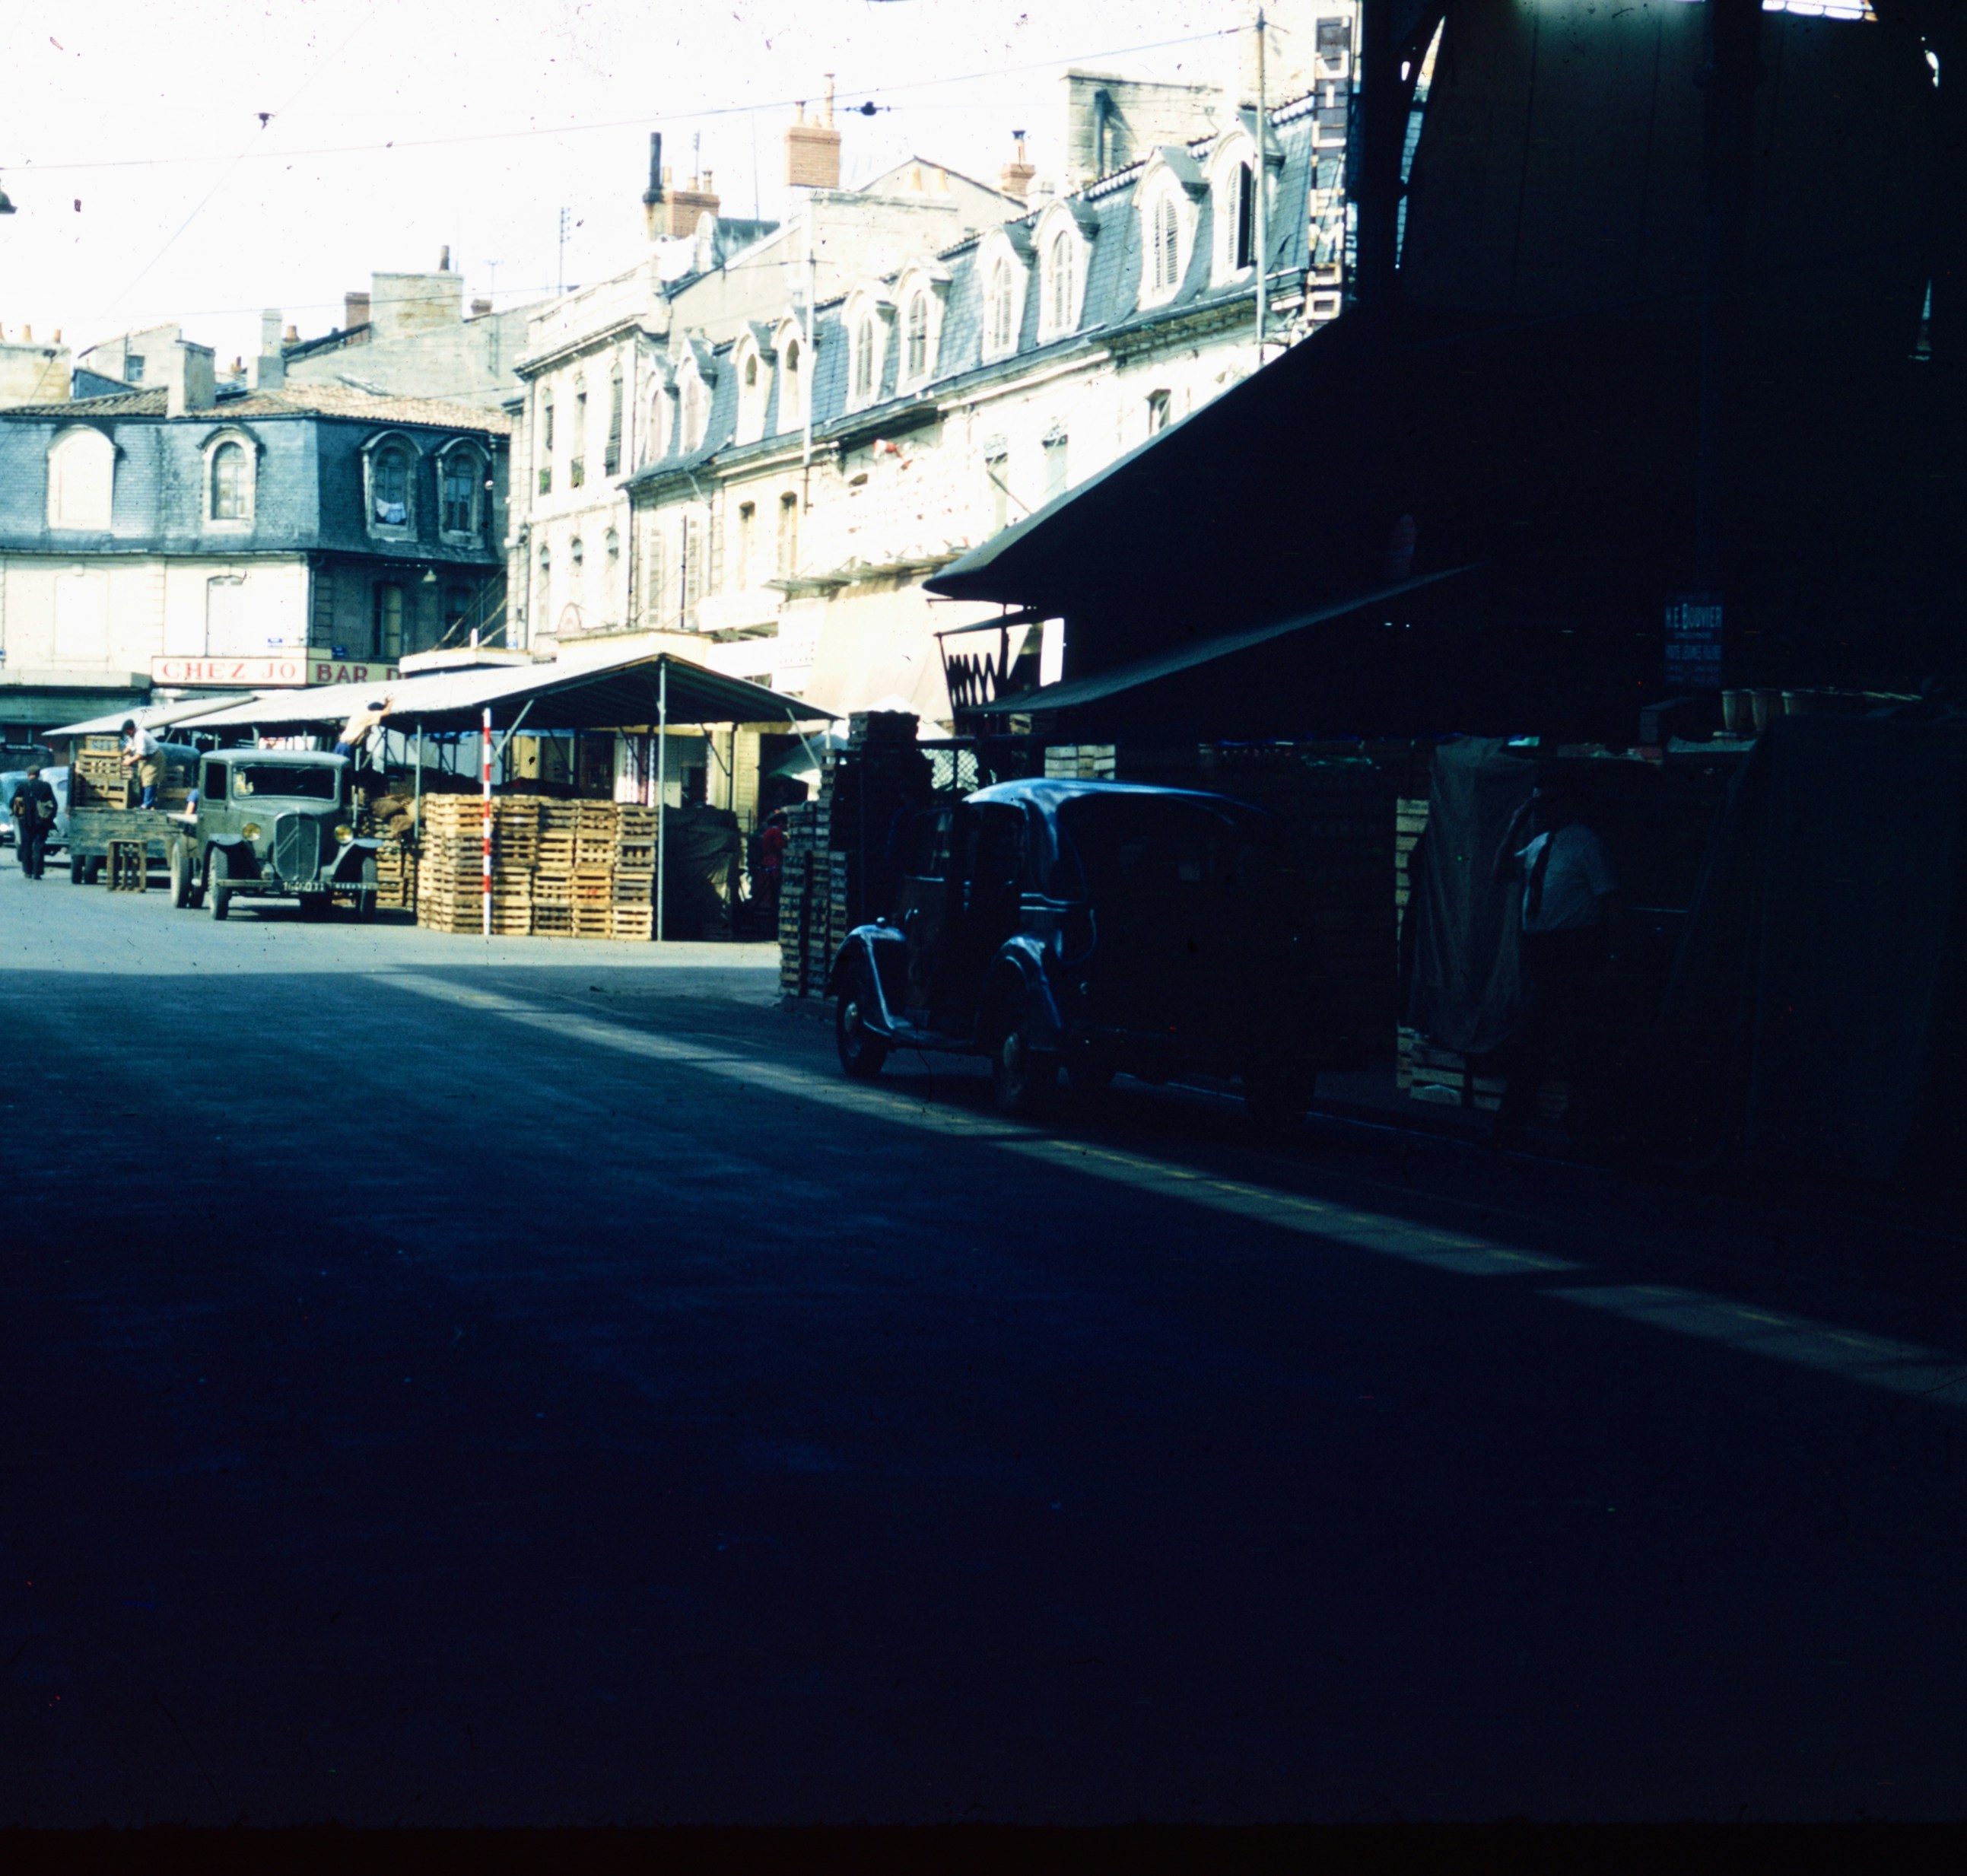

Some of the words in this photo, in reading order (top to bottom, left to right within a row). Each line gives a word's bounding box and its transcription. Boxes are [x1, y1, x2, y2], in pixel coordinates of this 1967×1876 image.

[162, 663, 246, 679] CHEZ
[262, 663, 297, 679] JO
[316, 663, 369, 684] BAR
